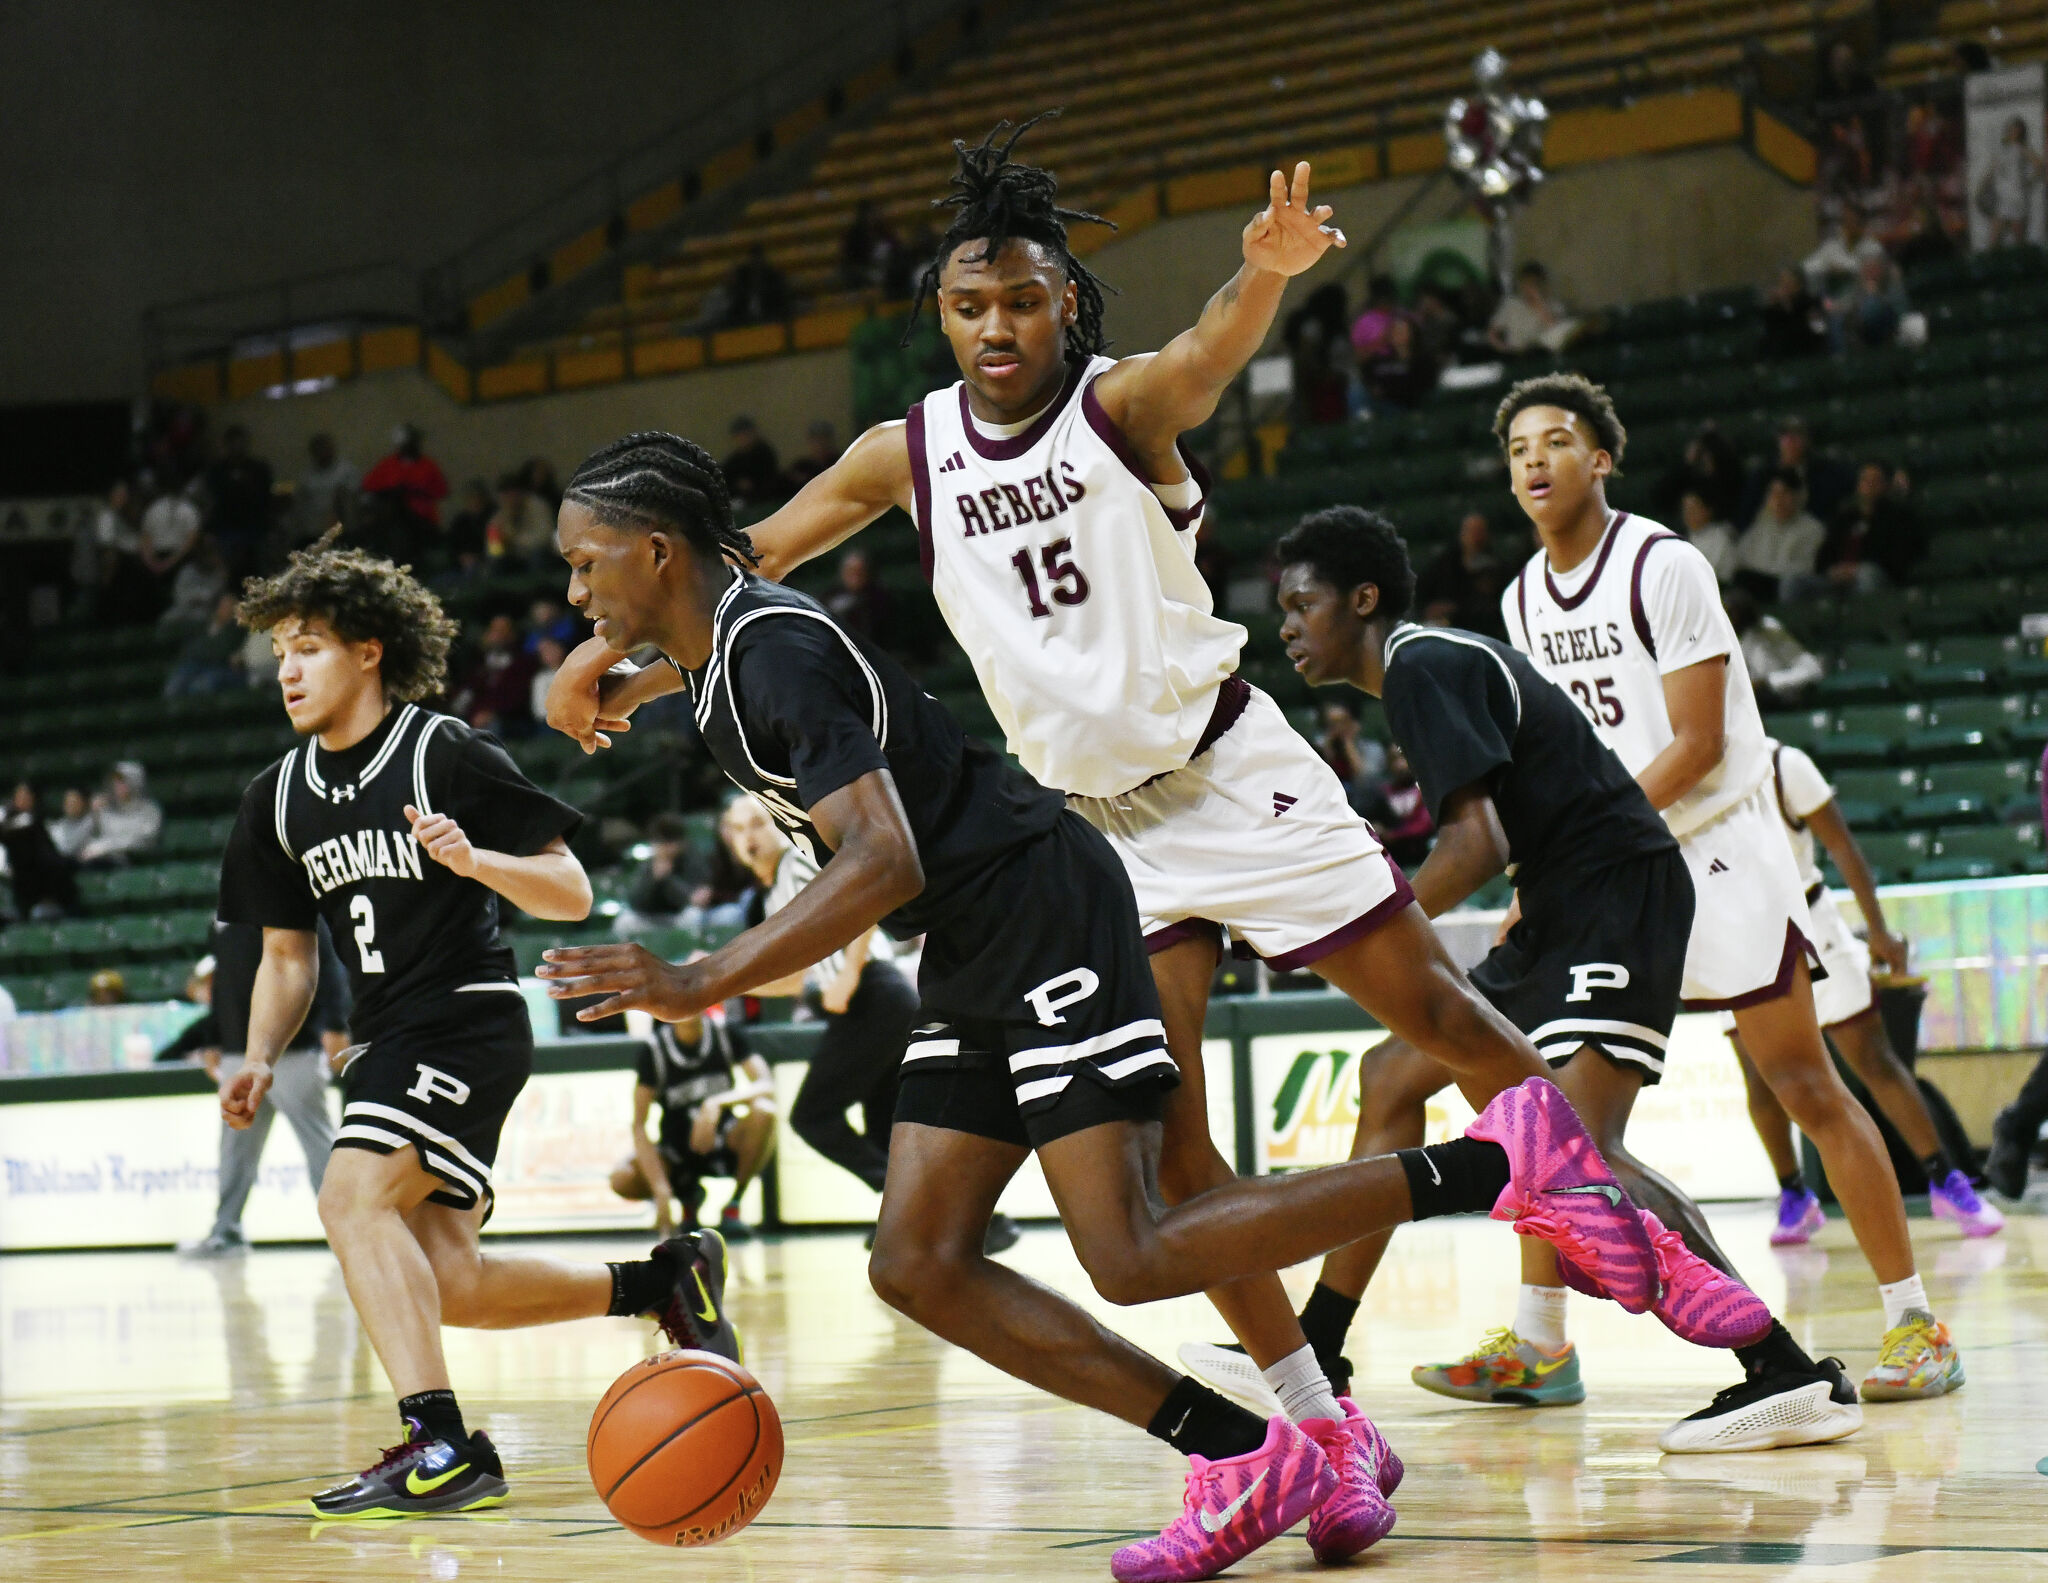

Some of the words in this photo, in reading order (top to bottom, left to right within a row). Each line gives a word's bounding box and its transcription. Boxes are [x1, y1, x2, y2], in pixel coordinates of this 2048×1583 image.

[957, 461, 1087, 537] REBELS
[1011, 537, 1090, 619] 15
[1570, 676, 1624, 727] 35
[350, 895, 385, 973] 2
[1024, 967, 1099, 1027] P
[1566, 963, 1629, 1002] P
[406, 1063, 470, 1105] P
